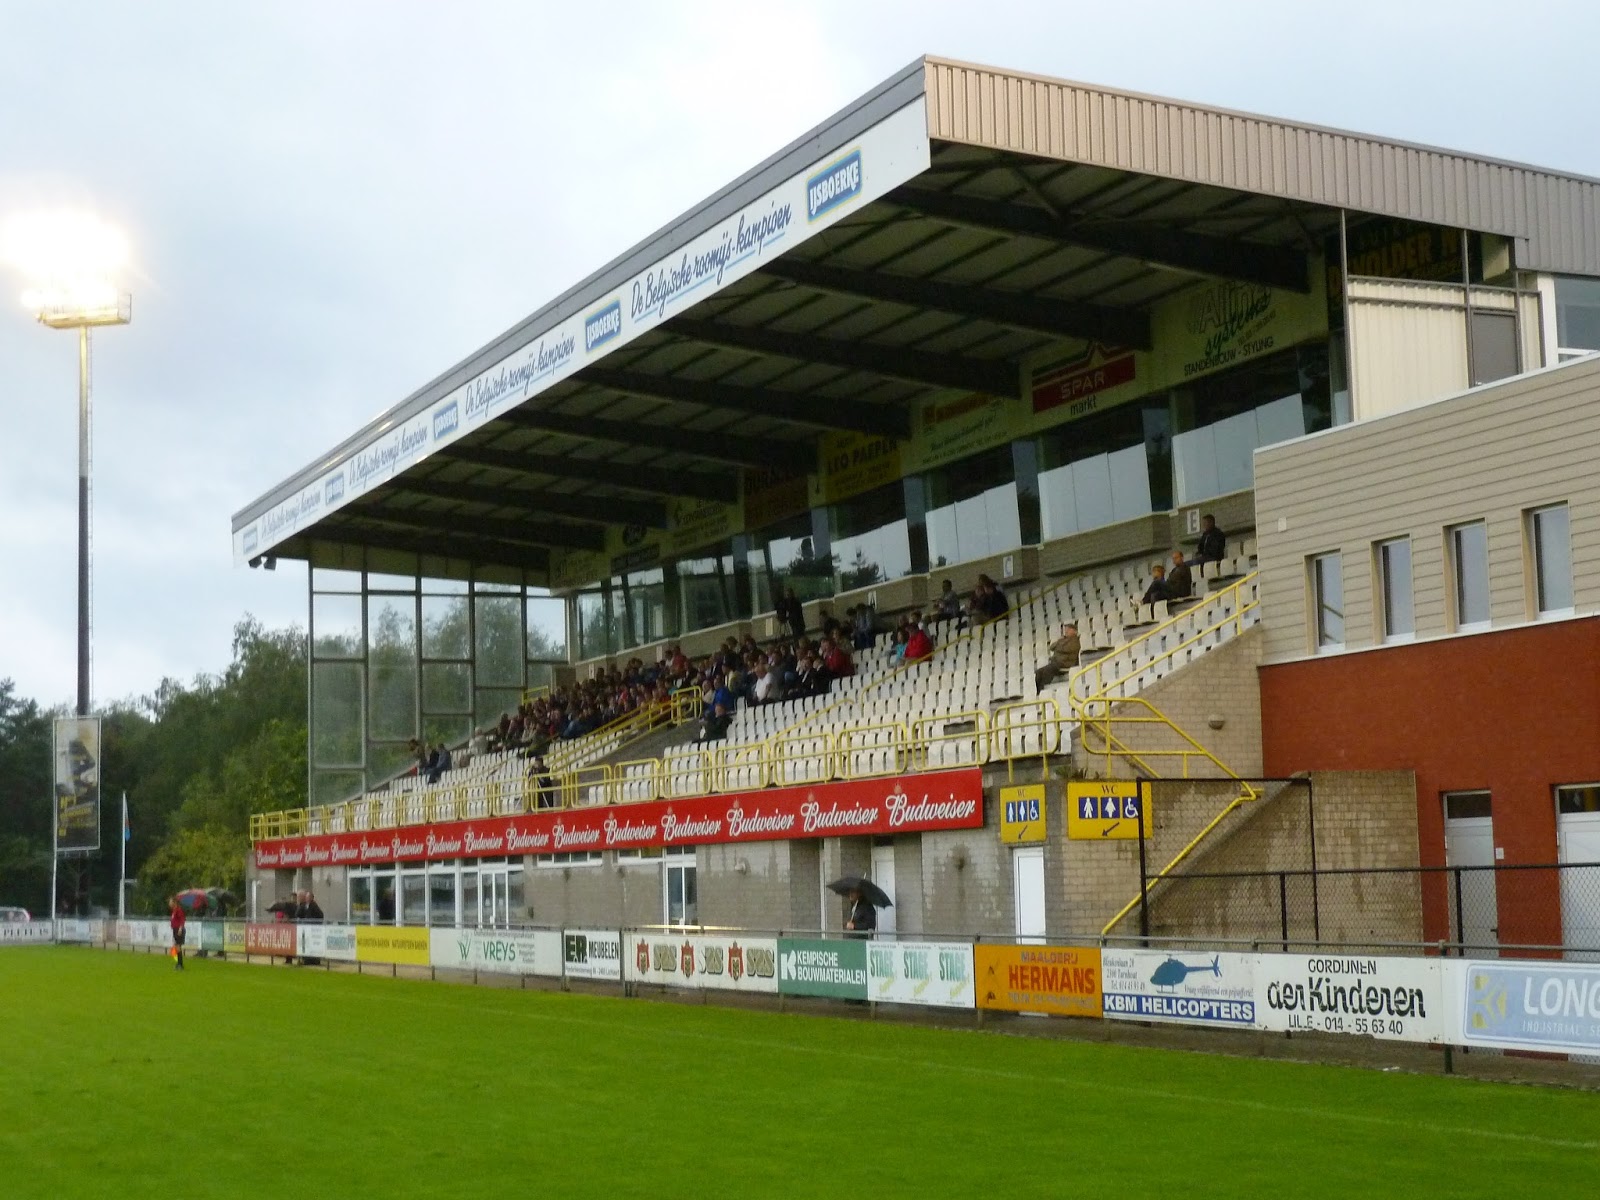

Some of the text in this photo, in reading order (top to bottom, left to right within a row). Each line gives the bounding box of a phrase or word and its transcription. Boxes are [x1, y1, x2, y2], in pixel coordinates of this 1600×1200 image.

[809, 160, 860, 215] IJSBOERKE
[631, 281, 644, 318] De
[645, 253, 692, 318] Belgische
[586, 308, 620, 346] IJSBOERKE
[1243, 336, 1274, 356] STYLING
[1060, 371, 1105, 400] SPAR
[1070, 395, 1097, 415] markt
[1017, 789, 1026, 798] WC
[1101, 785, 1118, 795] WC
[800, 800, 878, 832] Budweiser
[885, 793, 975, 826] Budweiser
[603, 818, 656, 844] Budweiser
[661, 813, 721, 841] Budweiser
[726, 807, 794, 837] Budweiser
[392, 837, 424, 859] Budweiser
[426, 834, 461, 855] Budweiser
[464, 830, 503, 853] Budweiser
[506, 826, 550, 850] Budweiser
[552, 824, 600, 849] Budweiser
[483, 940, 516, 961] VREYS
[588, 941, 619, 959] MEUBELEN
[797, 950, 839, 967] KEMPISCHE
[797, 965, 866, 985] BOUWMATERIALEN
[1308, 958, 1377, 975] GORDIJNEN
[1008, 964, 1096, 994] HERMANS
[1104, 995, 1138, 1012] KBM
[1142, 998, 1253, 1020] HELICOPTERS
[1308, 976, 1426, 1018] Kinderen
[1355, 1018, 1368, 1032] 55
[1371, 1019, 1384, 1033] 63
[1388, 1020, 1403, 1035] 40
[1522, 1020, 1581, 1036] INDUSTRIAL
